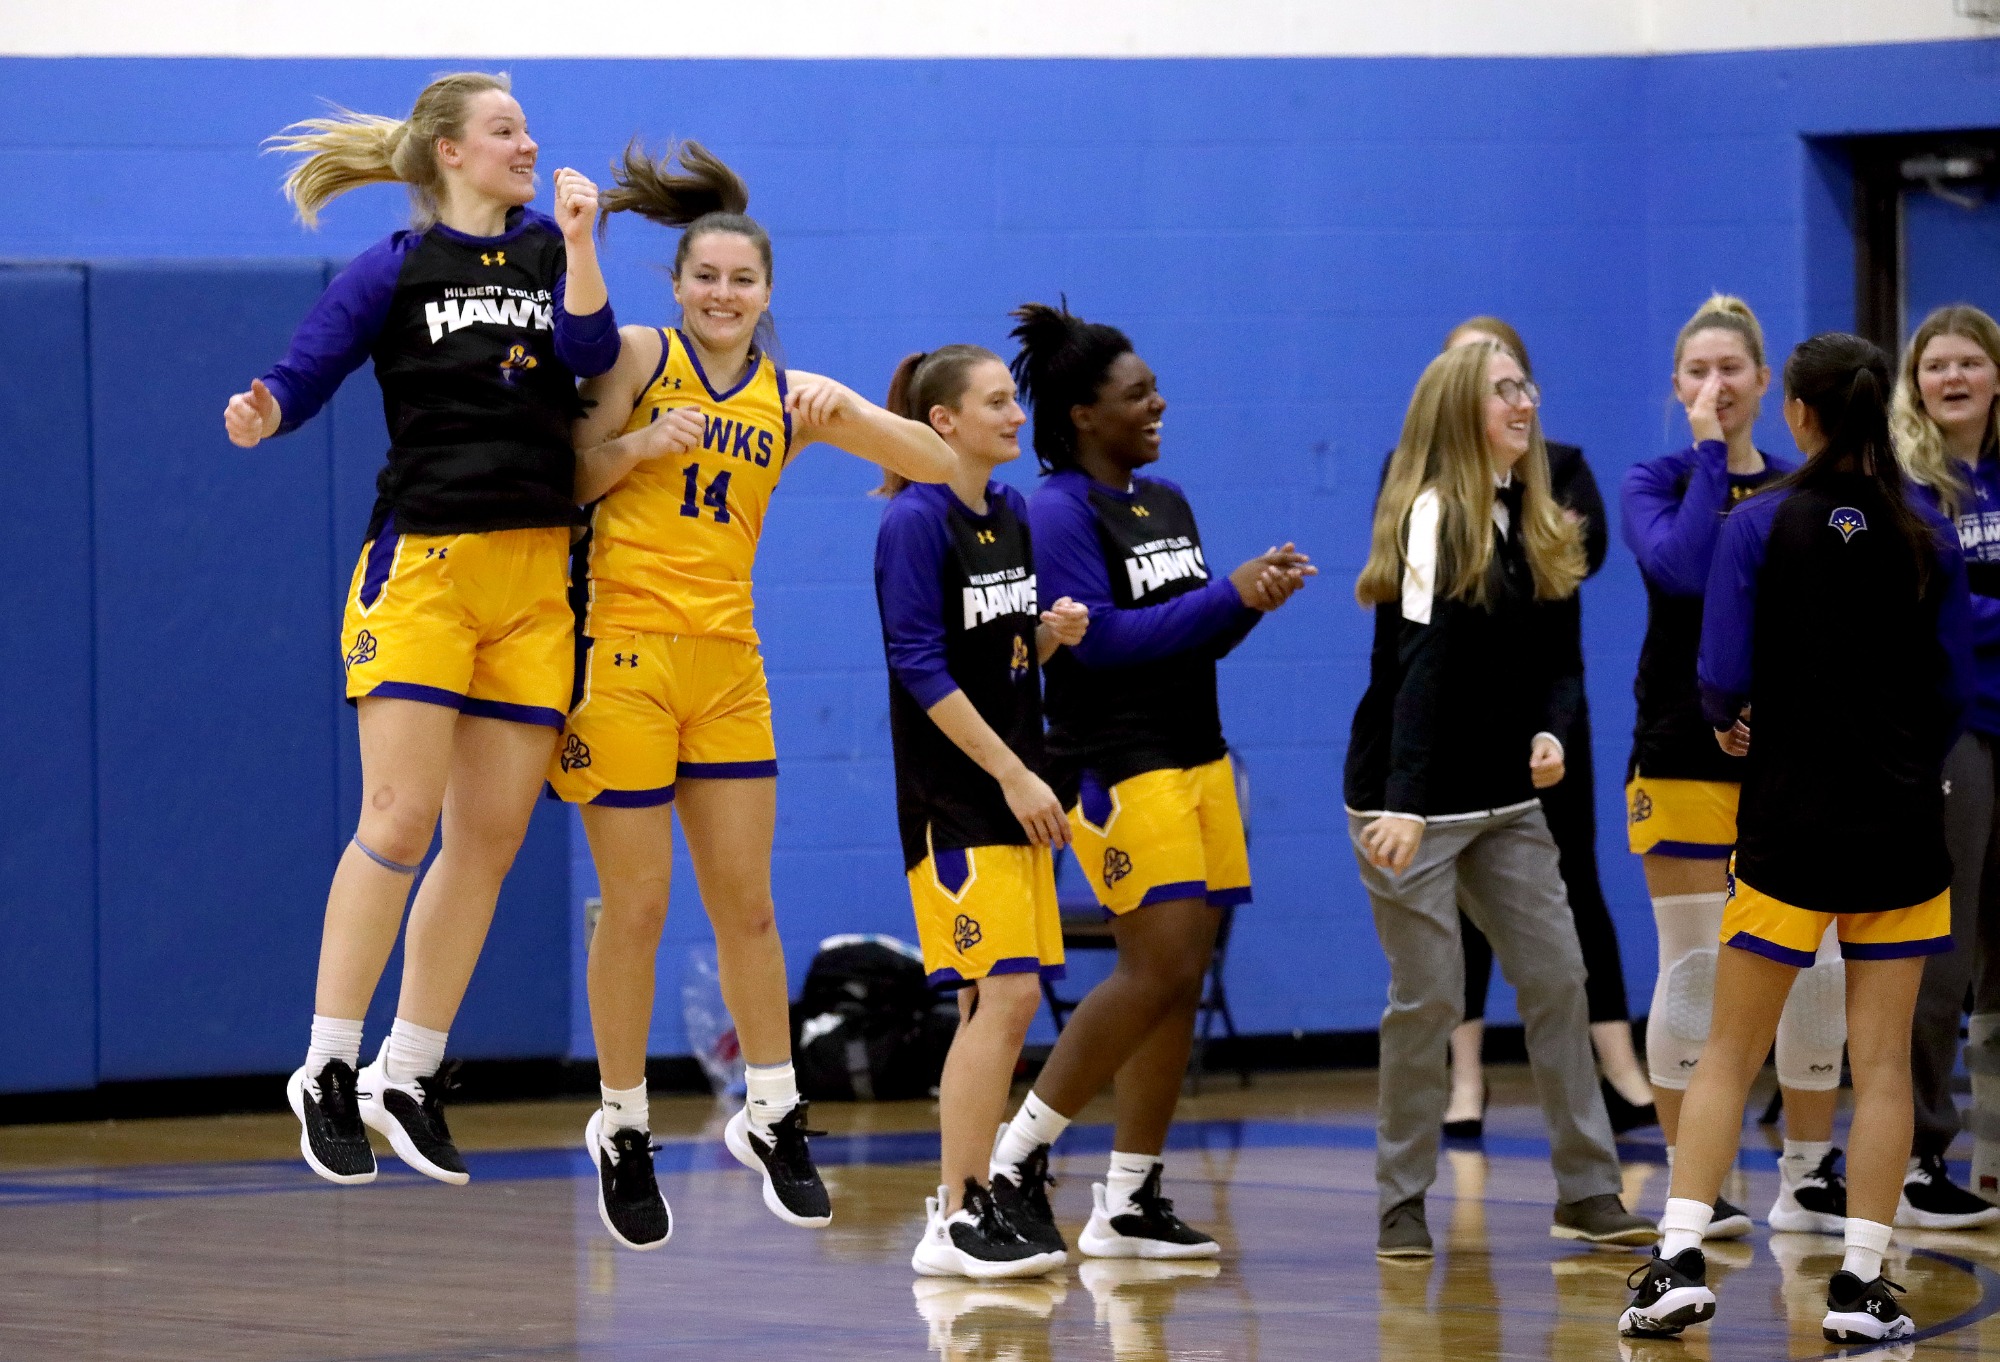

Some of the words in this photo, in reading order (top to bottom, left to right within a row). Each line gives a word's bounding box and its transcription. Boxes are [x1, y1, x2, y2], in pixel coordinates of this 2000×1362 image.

[444, 285, 503, 299] HILBERT
[424, 298, 555, 345] HAWK
[651, 407, 774, 469] WKS
[680, 462, 732, 524] 14
